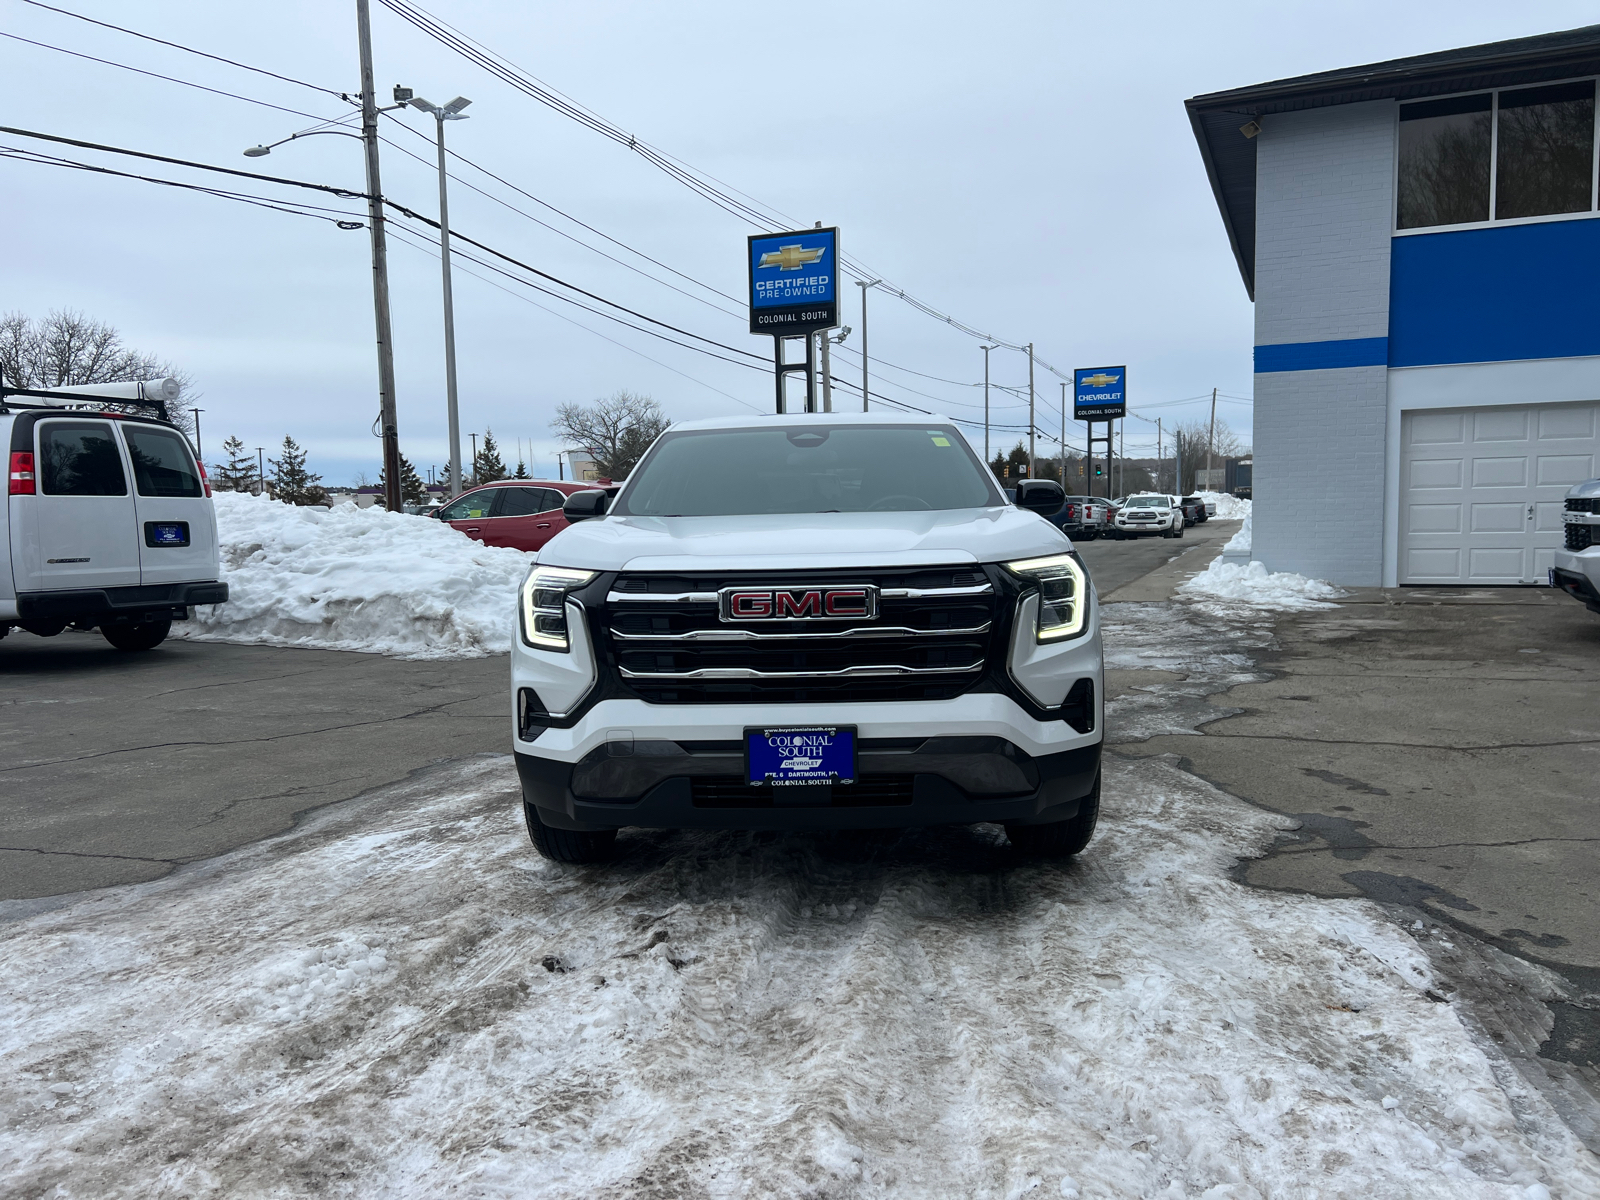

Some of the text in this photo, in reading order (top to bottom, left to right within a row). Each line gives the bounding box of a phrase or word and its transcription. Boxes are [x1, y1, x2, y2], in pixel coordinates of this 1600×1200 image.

[756, 276, 828, 290] CERTIFIED
[759, 286, 825, 299] PRE-OWNED
[758, 311, 828, 324] COLONIAL SOUTH
[1078, 393, 1122, 401] CHEVROLET
[731, 590, 867, 617] GMC
[768, 735, 833, 747] COLONIAL
[778, 746, 823, 757] SOUTH
